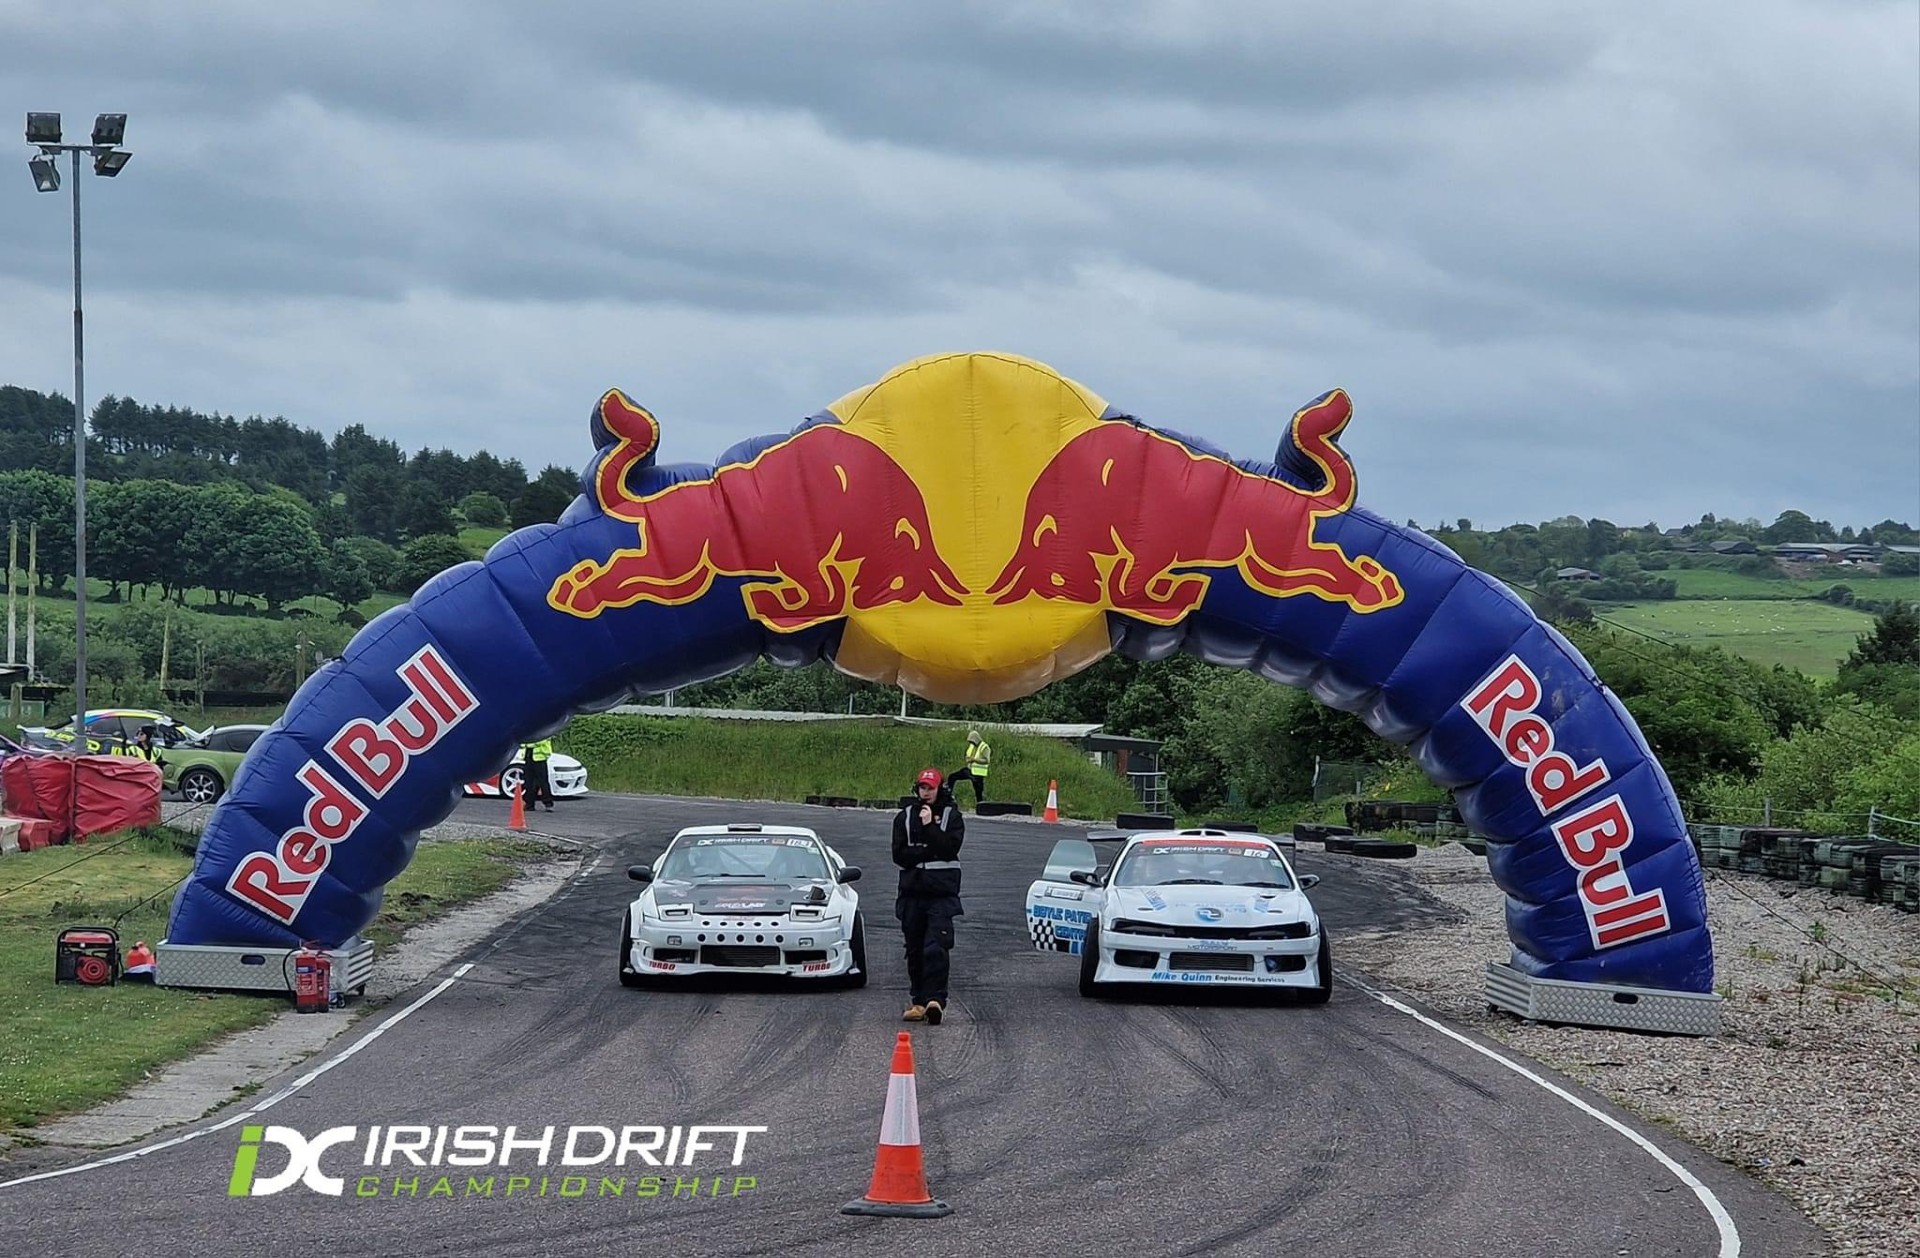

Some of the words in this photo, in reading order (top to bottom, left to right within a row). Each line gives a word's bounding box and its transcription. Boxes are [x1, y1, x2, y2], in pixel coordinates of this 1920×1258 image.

[227, 759, 370, 924] Red
[325, 644, 479, 799] Bull
[1461, 654, 1610, 816] Red
[1552, 794, 1669, 949] Bull
[649, 961, 675, 971] TURBO
[802, 962, 831, 972] TURBO
[1151, 972, 1177, 981] Mike
[1181, 973, 1212, 982] Quinn
[1214, 975, 1256, 983] Engineering
